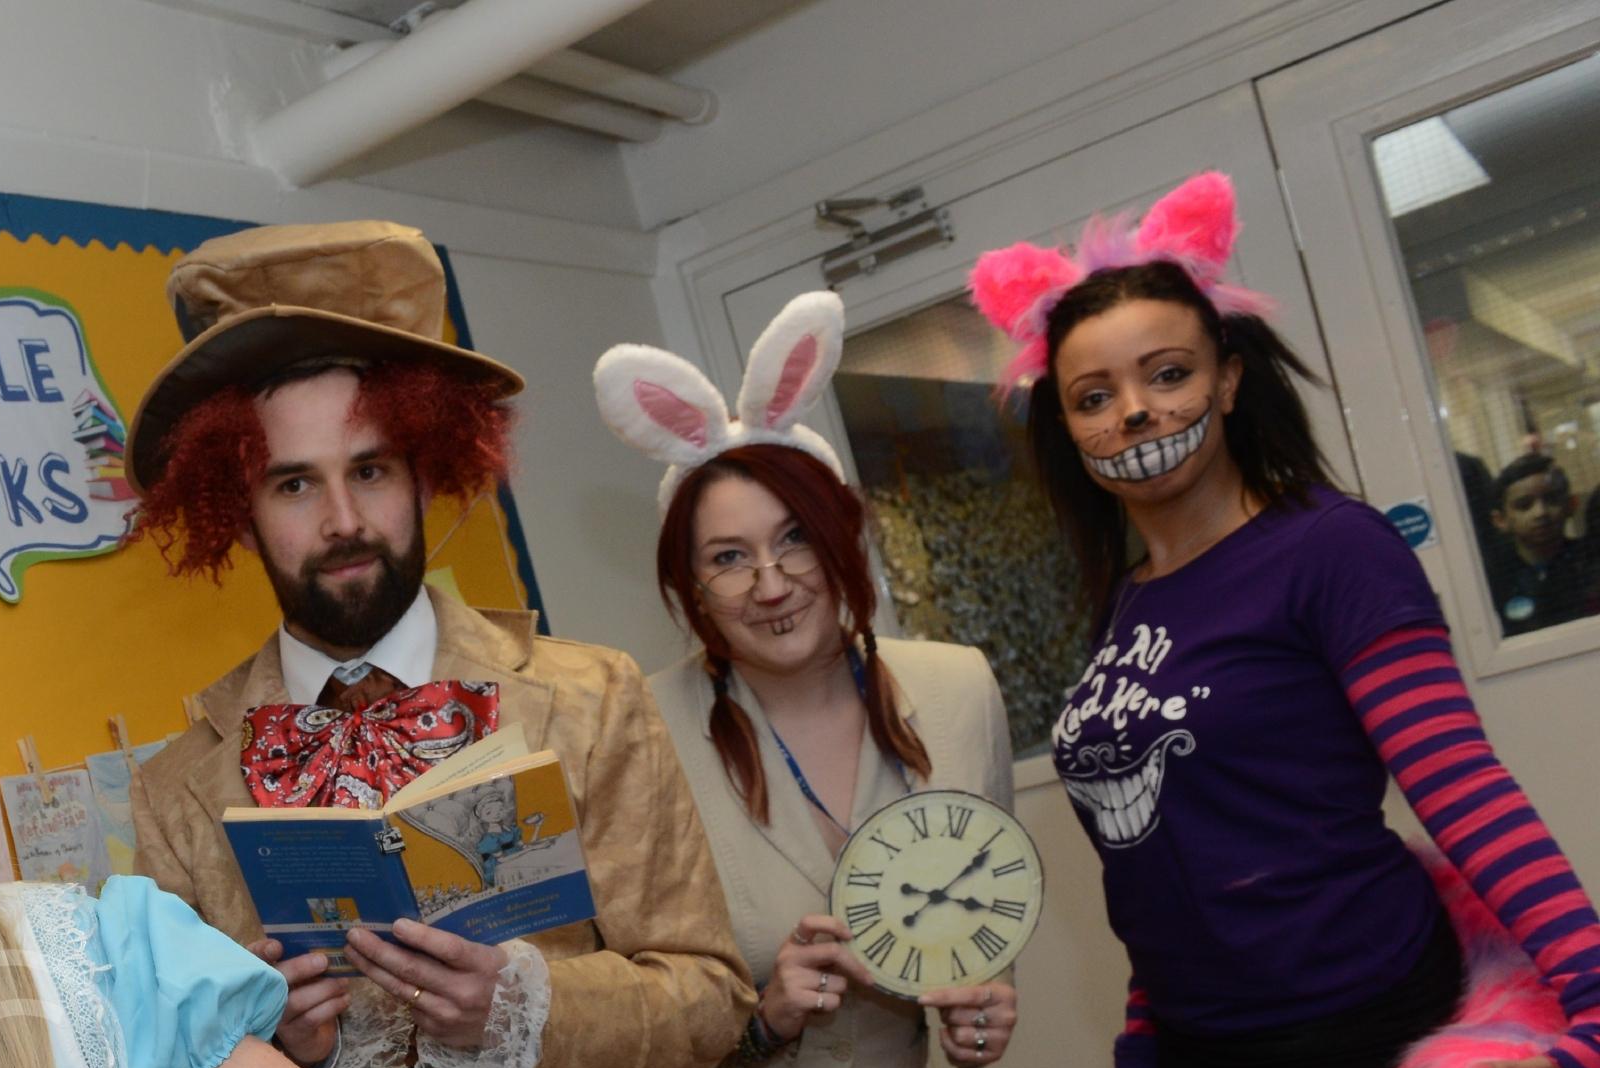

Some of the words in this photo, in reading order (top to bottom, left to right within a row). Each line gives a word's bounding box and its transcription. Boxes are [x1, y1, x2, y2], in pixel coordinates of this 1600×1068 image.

[903, 806, 931, 843] XI
[940, 804, 974, 840] XII
[869, 828, 902, 860] X
[847, 865, 884, 890] IX
[992, 859, 1026, 878] II
[991, 899, 1026, 922] III
[864, 930, 897, 968] VII
[899, 946, 922, 982] VI
[951, 949, 968, 981] V
